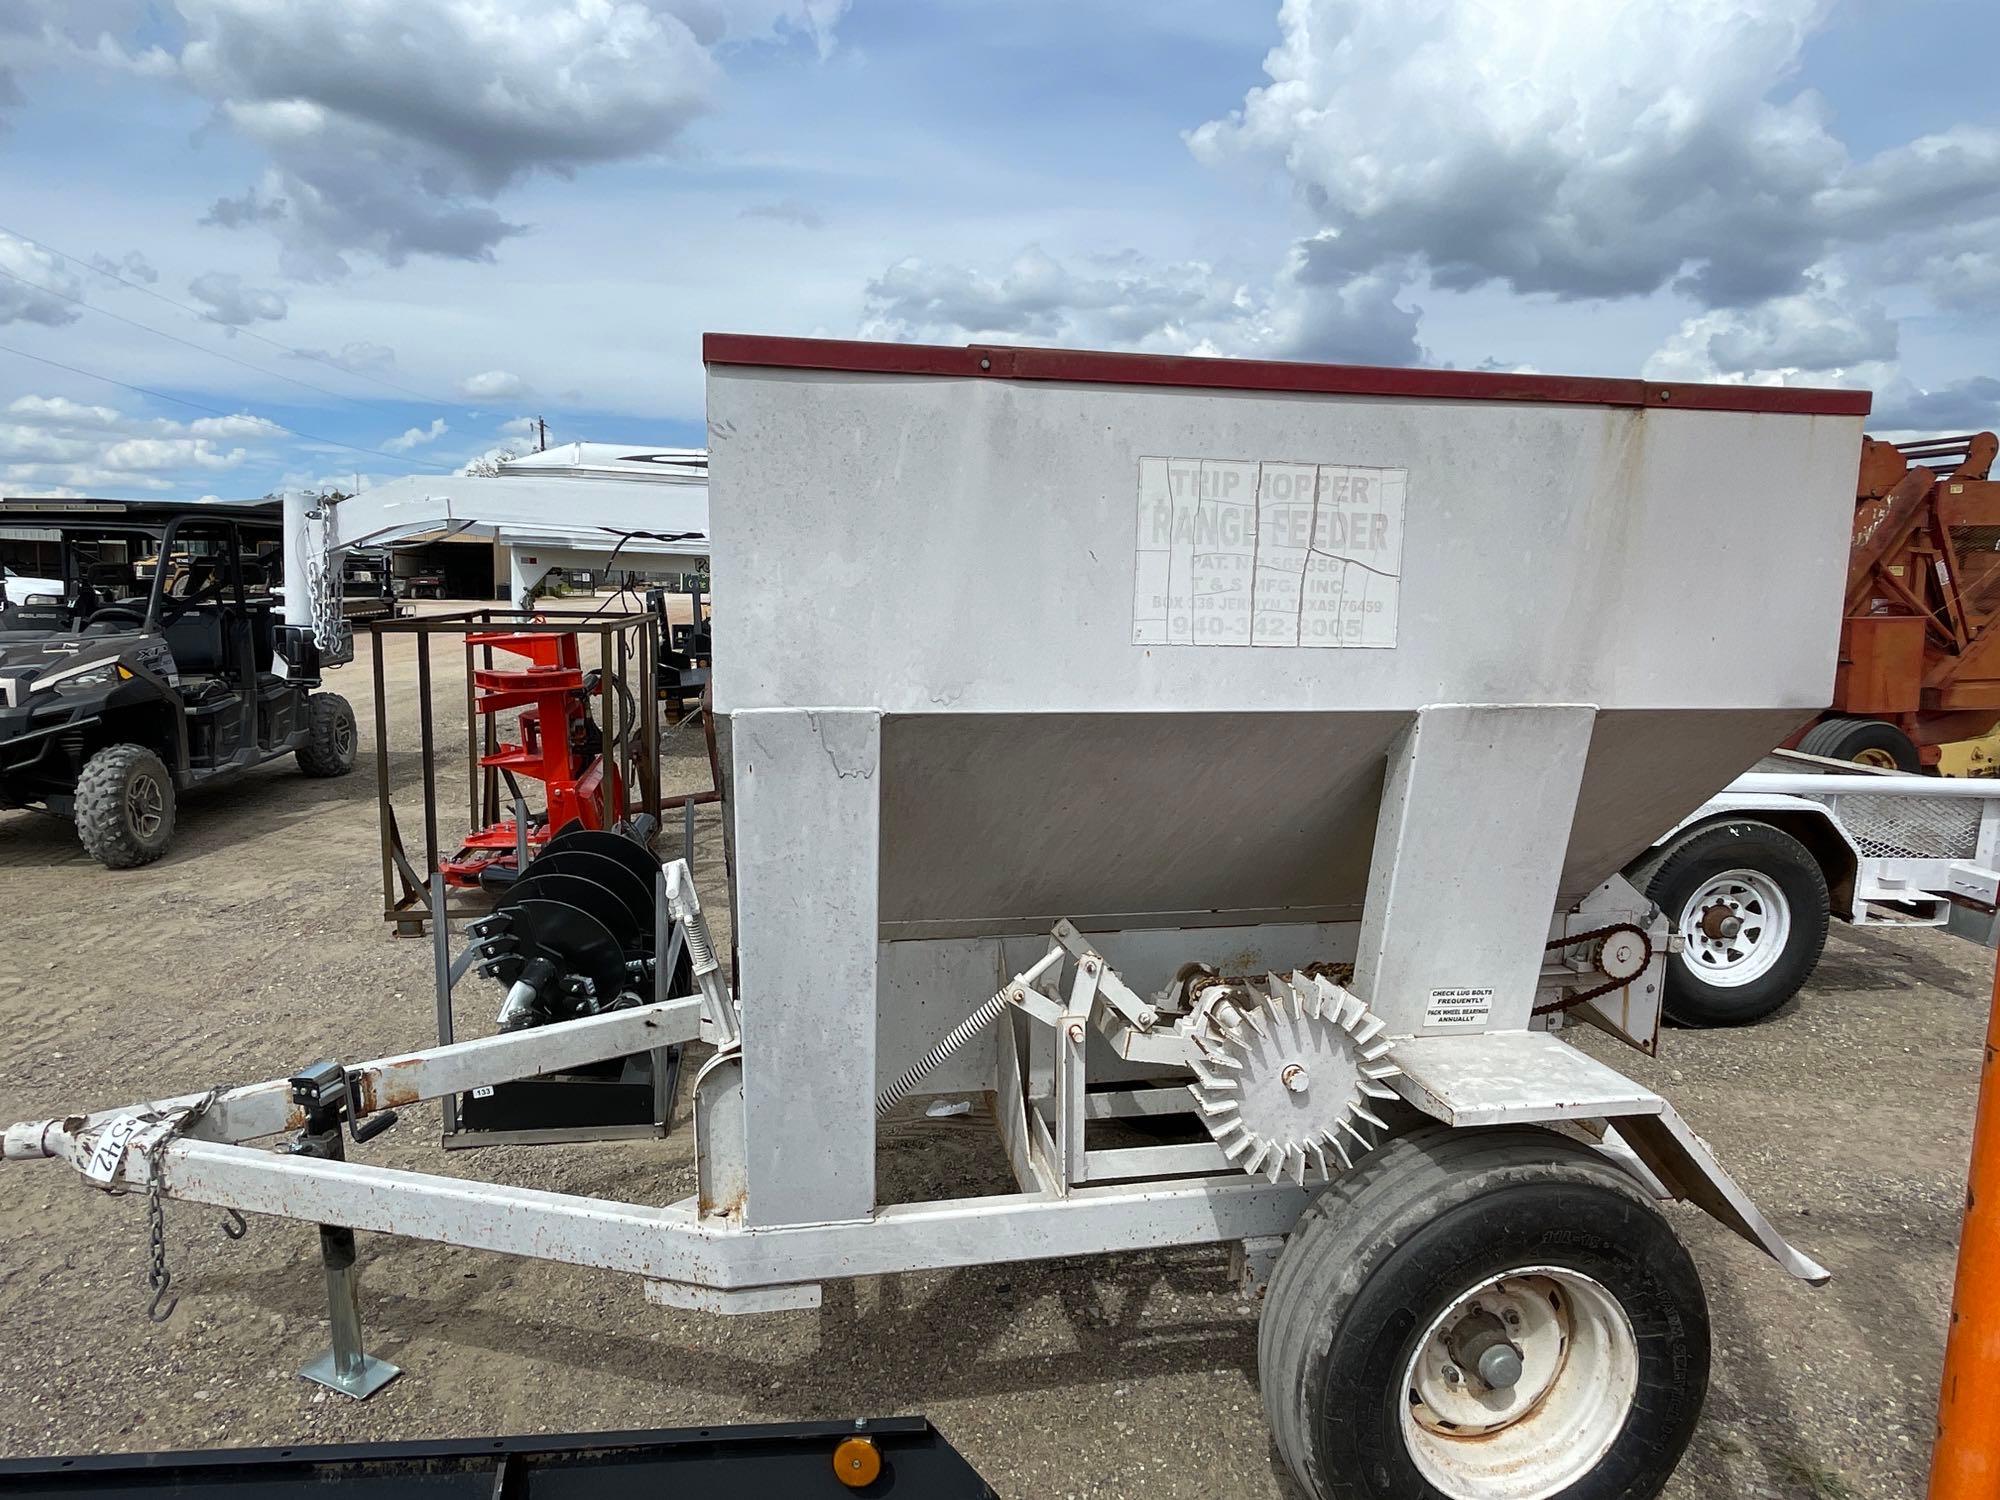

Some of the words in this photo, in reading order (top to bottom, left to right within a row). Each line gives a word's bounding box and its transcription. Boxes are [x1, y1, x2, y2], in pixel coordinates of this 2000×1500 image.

[1170, 469, 1240, 497] TRIP
[1250, 472, 1369, 504] HOPPER
[1273, 510, 1388, 551] FEEDER
[1210, 577, 1223, 592] &
[1231, 577, 1242, 592] S
[1442, 1008, 1461, 1016] WHEEL
[477, 1088, 491, 1096] 133
